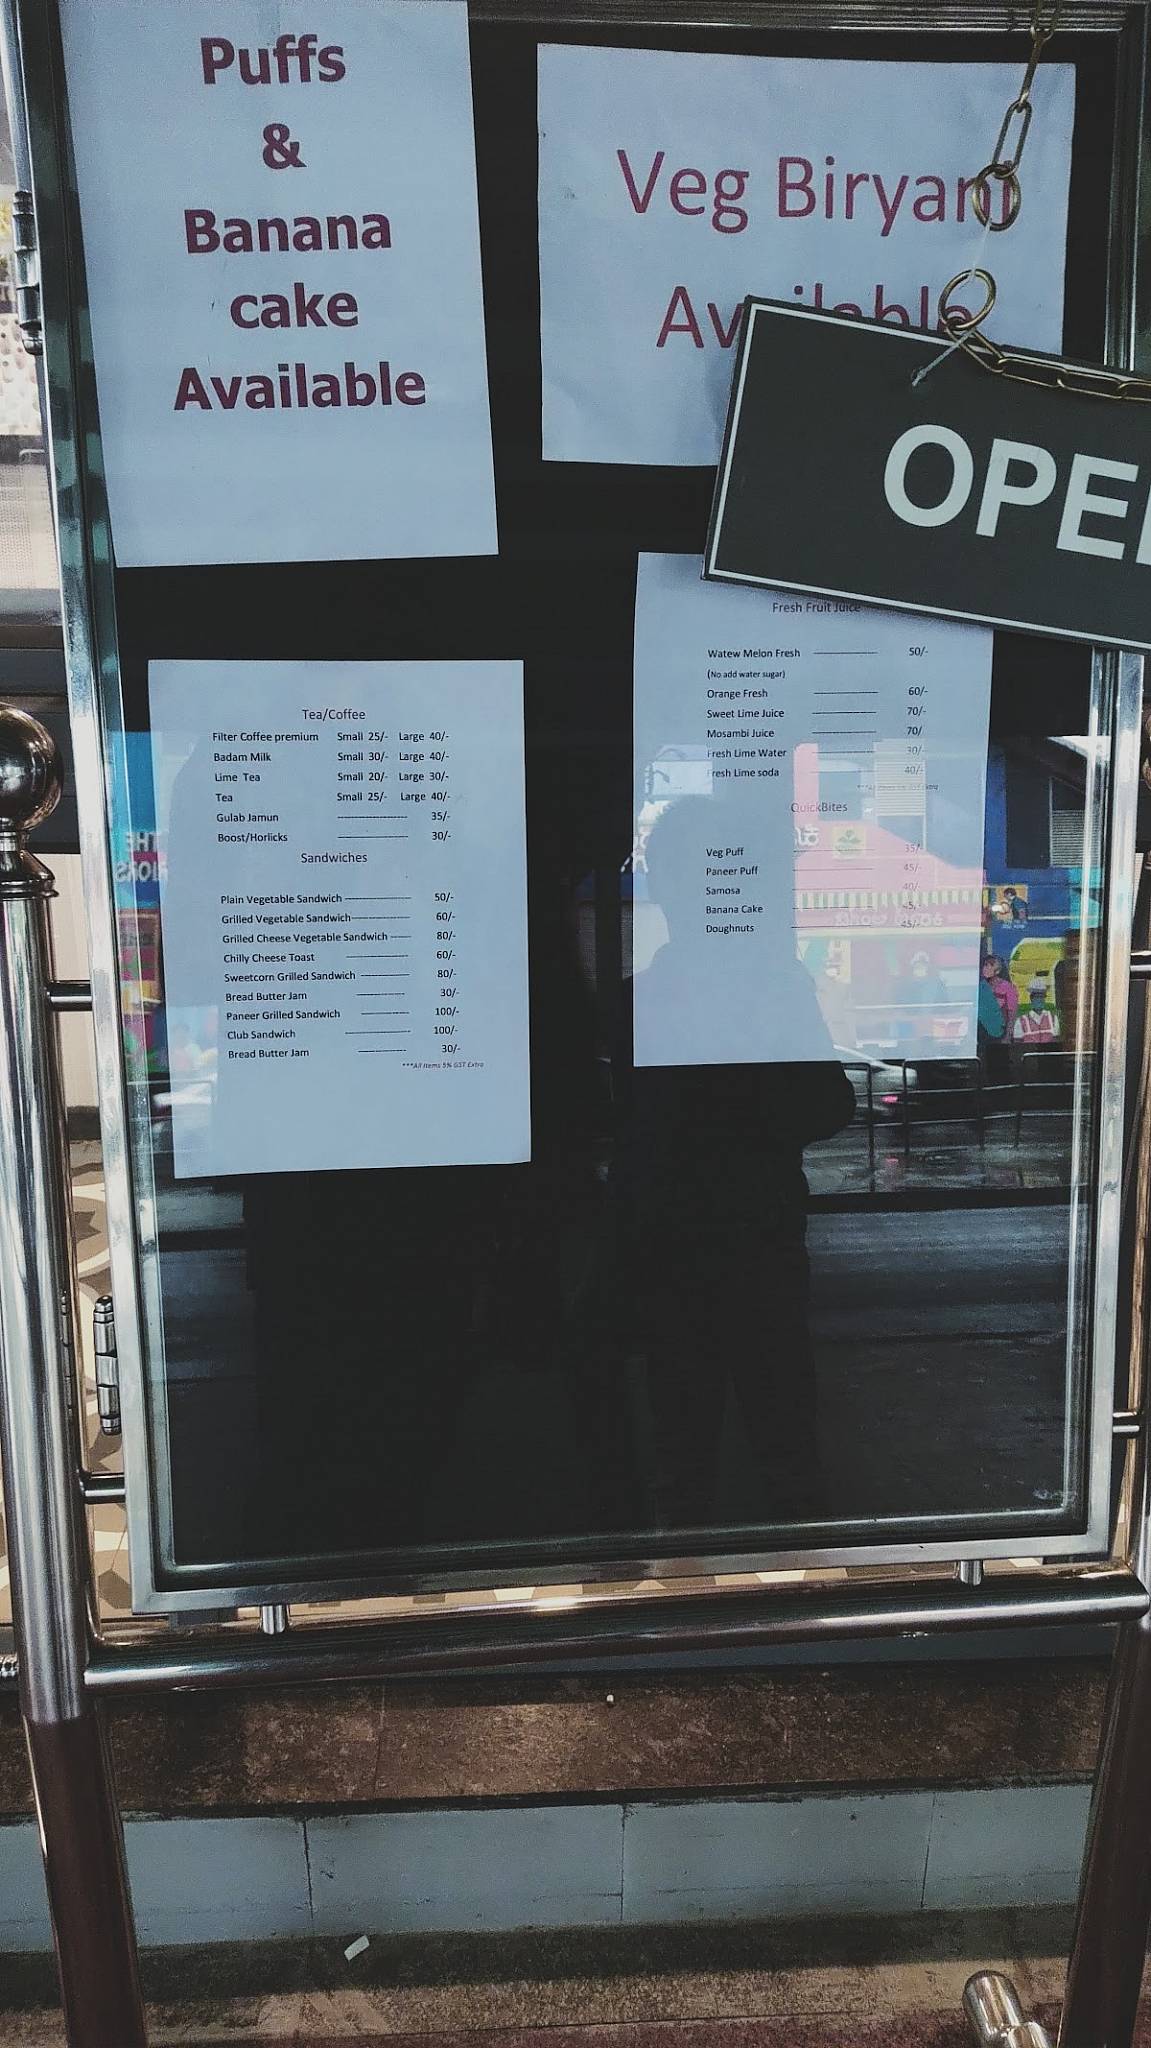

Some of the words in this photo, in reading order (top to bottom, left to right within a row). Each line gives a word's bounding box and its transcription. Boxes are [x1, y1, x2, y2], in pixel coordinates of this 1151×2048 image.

[200, 34, 346, 85] Puffs
[263, 123, 307, 170] &
[617, 150, 750, 234] Veg
[184, 209, 391, 254] Banana
[230, 282, 358, 329] cake
[174, 361, 426, 410] Available
[884, 424, 1151, 565] OPE
[773, 602, 802, 612] Fresh
[806, 602, 831, 612] Fruit
[834, 602, 861, 612] Juice
[708, 649, 740, 658] Watew
[743, 649, 772, 658] Melon
[776, 648, 800, 657] Fresh
[909, 646, 928, 657] 50/-
[708, 669, 721, 680] (No
[723, 670, 737, 678] add
[762, 670, 785, 679] sugar)
[707, 690, 741, 700] Orange
[743, 689, 768, 697] Fresh
[909, 686, 928, 696] 60/-
[302, 708, 365, 722] Tea/Coffee
[707, 710, 734, 718] Sweet
[738, 709, 759, 717] Lime
[761, 709, 784, 717] Juice
[907, 706, 926, 716] 70/-
[213, 733, 238, 741] Filter
[240, 732, 272, 741] Coffee
[275, 732, 318, 743] premium
[338, 732, 363, 741] Small
[368, 731, 388, 742] 25/-
[399, 732, 424, 742] Large
[429, 731, 449, 741] 40/-
[707, 729, 749, 738] Mosambi
[751, 729, 775, 737] Juice
[214, 753, 247, 761] Badam
[251, 752, 271, 761] Milk
[338, 752, 363, 761] Small
[369, 752, 388, 762] 30/-
[399, 752, 424, 762] Large
[429, 751, 449, 762] 40/-
[758, 749, 787, 757] Water
[215, 773, 237, 781] Lime
[243, 773, 260, 781] Tea
[338, 772, 363, 781] Small
[369, 772, 387, 782] 20/-
[399, 773, 424, 782] Large
[430, 771, 449, 782] 30/-
[734, 769, 755, 777] Lime
[758, 768, 779, 777] soda
[215, 793, 232, 802] Tea
[337, 792, 362, 801] Small
[368, 792, 387, 802] 25/-
[401, 792, 426, 802] Large
[431, 791, 450, 802] 40/-
[791, 801, 848, 814] QuickBites
[217, 813, 245, 822] Gulab
[248, 813, 278, 822] Jamun
[432, 811, 450, 822] 35/-
[218, 833, 287, 843] Boost/Horlicks
[432, 831, 451, 841] 30/-
[301, 852, 367, 863] Sandwiches
[706, 849, 723, 858] Veg
[726, 847, 744, 856] Puff
[905, 844, 923, 854] 35/-
[707, 868, 737, 876] Paneer
[740, 866, 758, 875] Puff
[904, 864, 922, 872] 45/-
[706, 887, 740, 895] Samosa
[221, 896, 244, 904] Plain
[246, 895, 294, 905] Vegetable
[297, 894, 342, 903] Sandwich
[435, 892, 454, 902] 50/-
[706, 906, 738, 914] Banana
[741, 905, 763, 913] Cake
[222, 915, 253, 924] Grilled
[256, 914, 304, 925] Vegetable
[306, 913, 351, 922] Sandwich
[436, 912, 455, 922] 60/-
[706, 924, 754, 934] Doughnuts
[223, 934, 254, 943] Grilled
[257, 934, 291, 943] Cheese
[293, 933, 341, 944] Vegetable
[344, 932, 387, 941] Sandwich
[437, 931, 456, 941] 80/-
[224, 954, 249, 964] Chilly
[252, 954, 286, 962] Cheese
[437, 950, 456, 960] 60/-
[224, 971, 276, 982] Sweetcorn
[277, 972, 308, 981] Grilled
[311, 971, 355, 980] Sandwich
[438, 969, 456, 979] 80/-
[226, 992, 253, 1001] Bread
[288, 992, 307, 1000] Jam
[440, 988, 459, 998] 30/-
[227, 1012, 260, 1020] Paneer
[262, 1011, 293, 1019] Grilled
[296, 1009, 340, 1019] Sandwich
[436, 1007, 459, 1016] 100/-
[227, 1030, 249, 1039] Club
[251, 1029, 295, 1039] Sandwich
[434, 1025, 458, 1035] 100/-
[229, 1050, 256, 1059] Bread
[259, 1050, 288, 1058] Butter
[291, 1049, 309, 1057] Jam
[442, 1044, 460, 1054] 30/-
